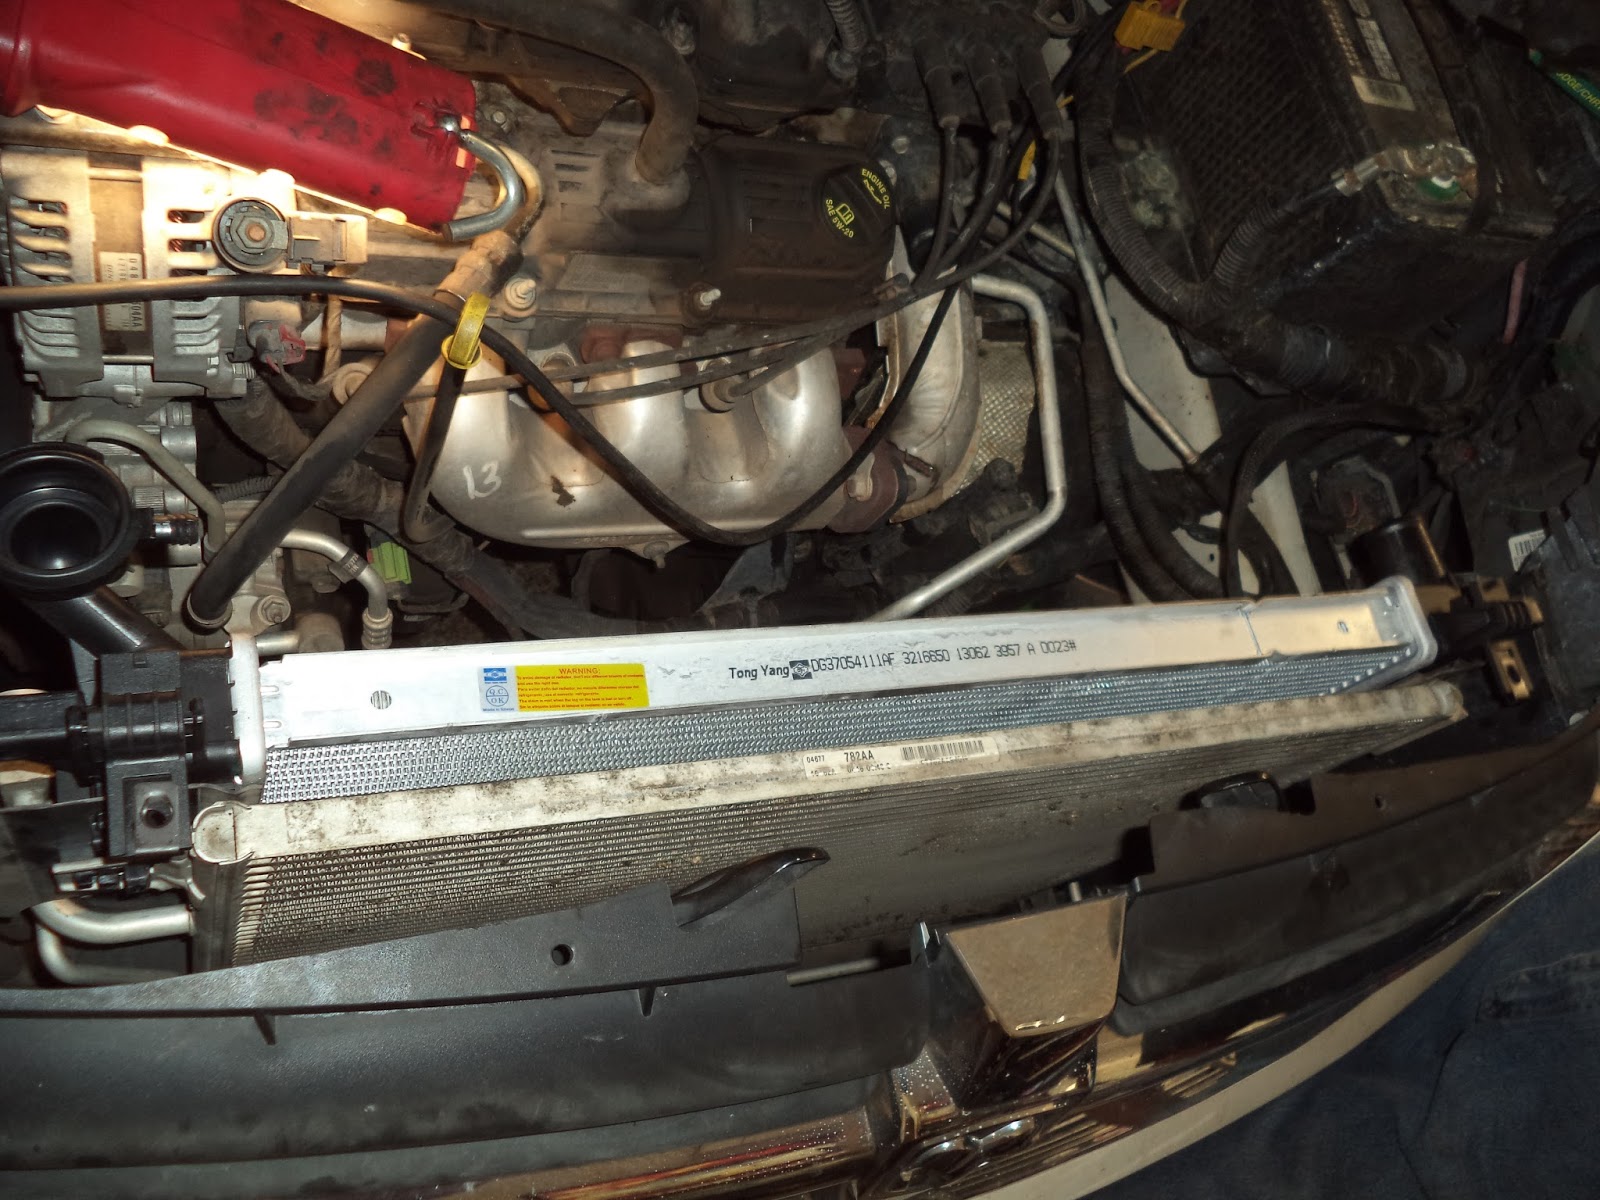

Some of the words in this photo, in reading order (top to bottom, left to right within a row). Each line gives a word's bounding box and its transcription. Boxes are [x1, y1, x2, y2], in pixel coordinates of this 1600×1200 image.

[1556, 72, 1600, 110] DGE/CHR
[861, 168, 887, 194] ENGINE
[882, 194, 891, 210] OIL
[825, 199, 836, 217] SAE
[832, 217, 854, 238] 5W-20
[462, 460, 502, 500] 13
[558, 667, 601, 675] WARNING:
[729, 667, 758, 681] Tong
[760, 664, 790, 679] Yang
[901, 649, 951, 665] 3216650
[956, 645, 991, 661] 13062
[1027, 642, 1036, 655] A
[1039, 639, 1077, 654] 0023#
[843, 750, 875, 763] 782AA
